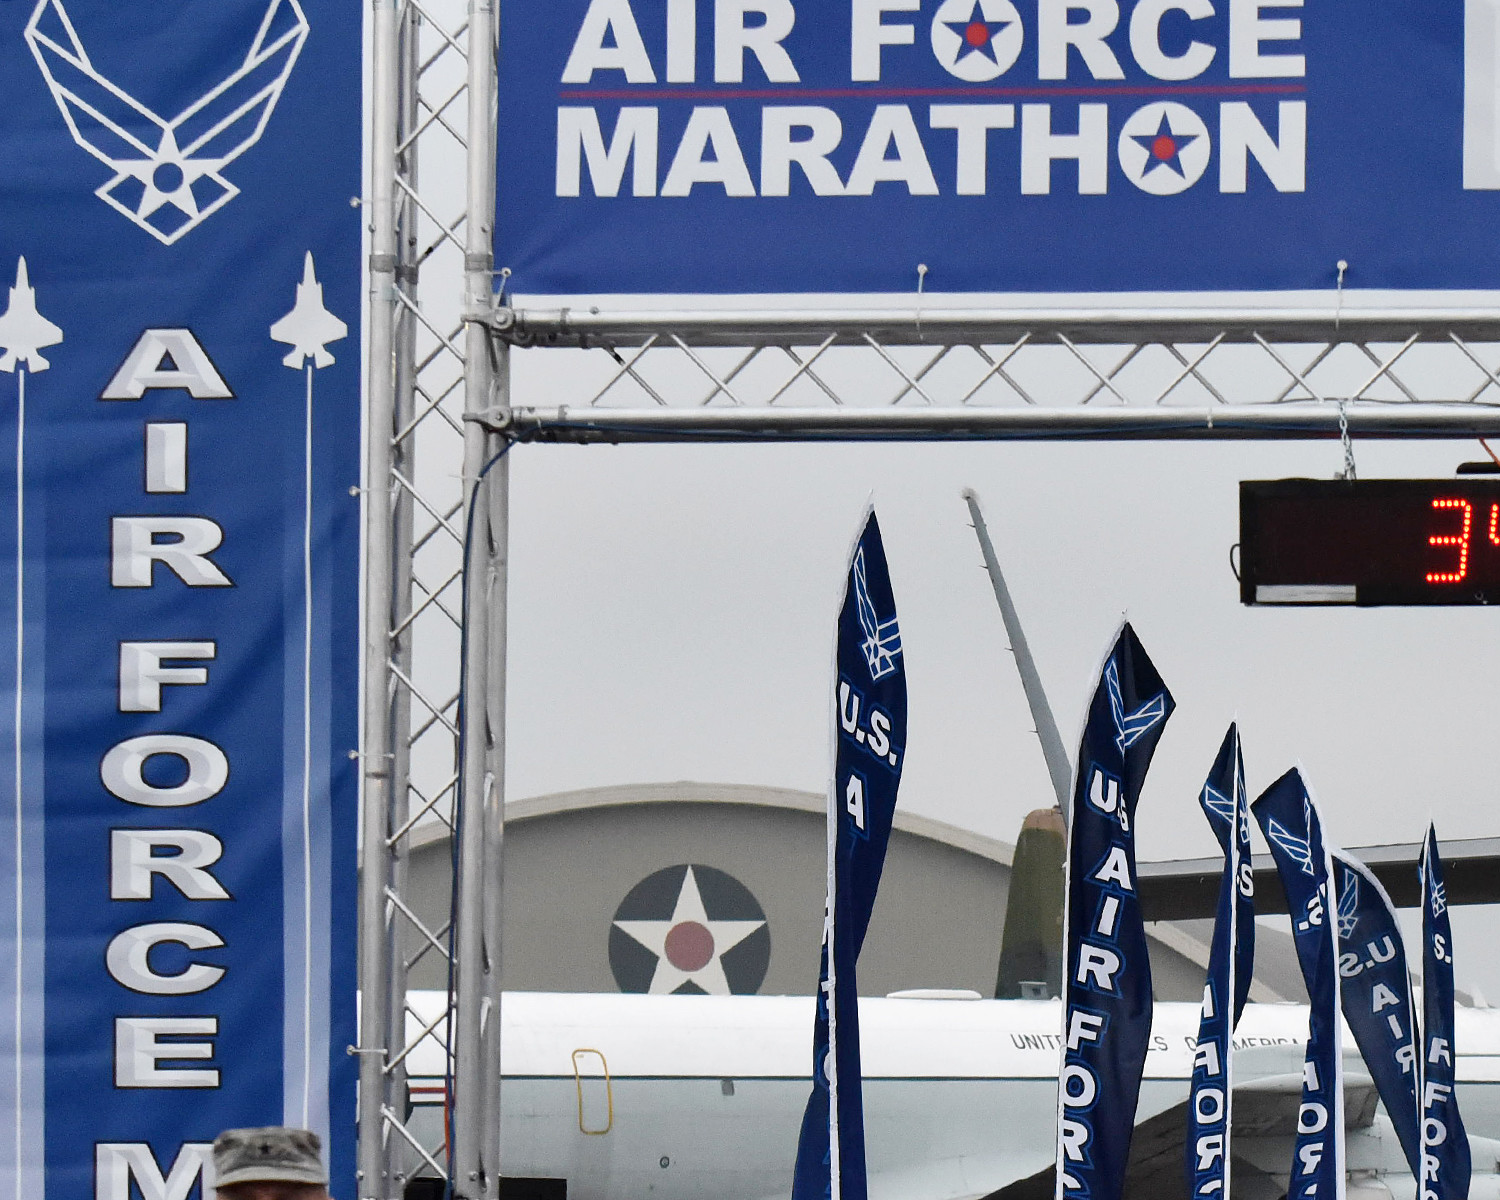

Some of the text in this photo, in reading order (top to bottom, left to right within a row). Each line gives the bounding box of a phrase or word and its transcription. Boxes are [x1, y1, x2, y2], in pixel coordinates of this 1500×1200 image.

[560, 0, 1306, 83] AIR FORCE
[555, 100, 1306, 197] MARATHON
[101, 328, 237, 588] AIR
[840, 681, 898, 766] U.S.
[100, 641, 233, 1087] FORCE
[1077, 847, 1132, 991] AIR
